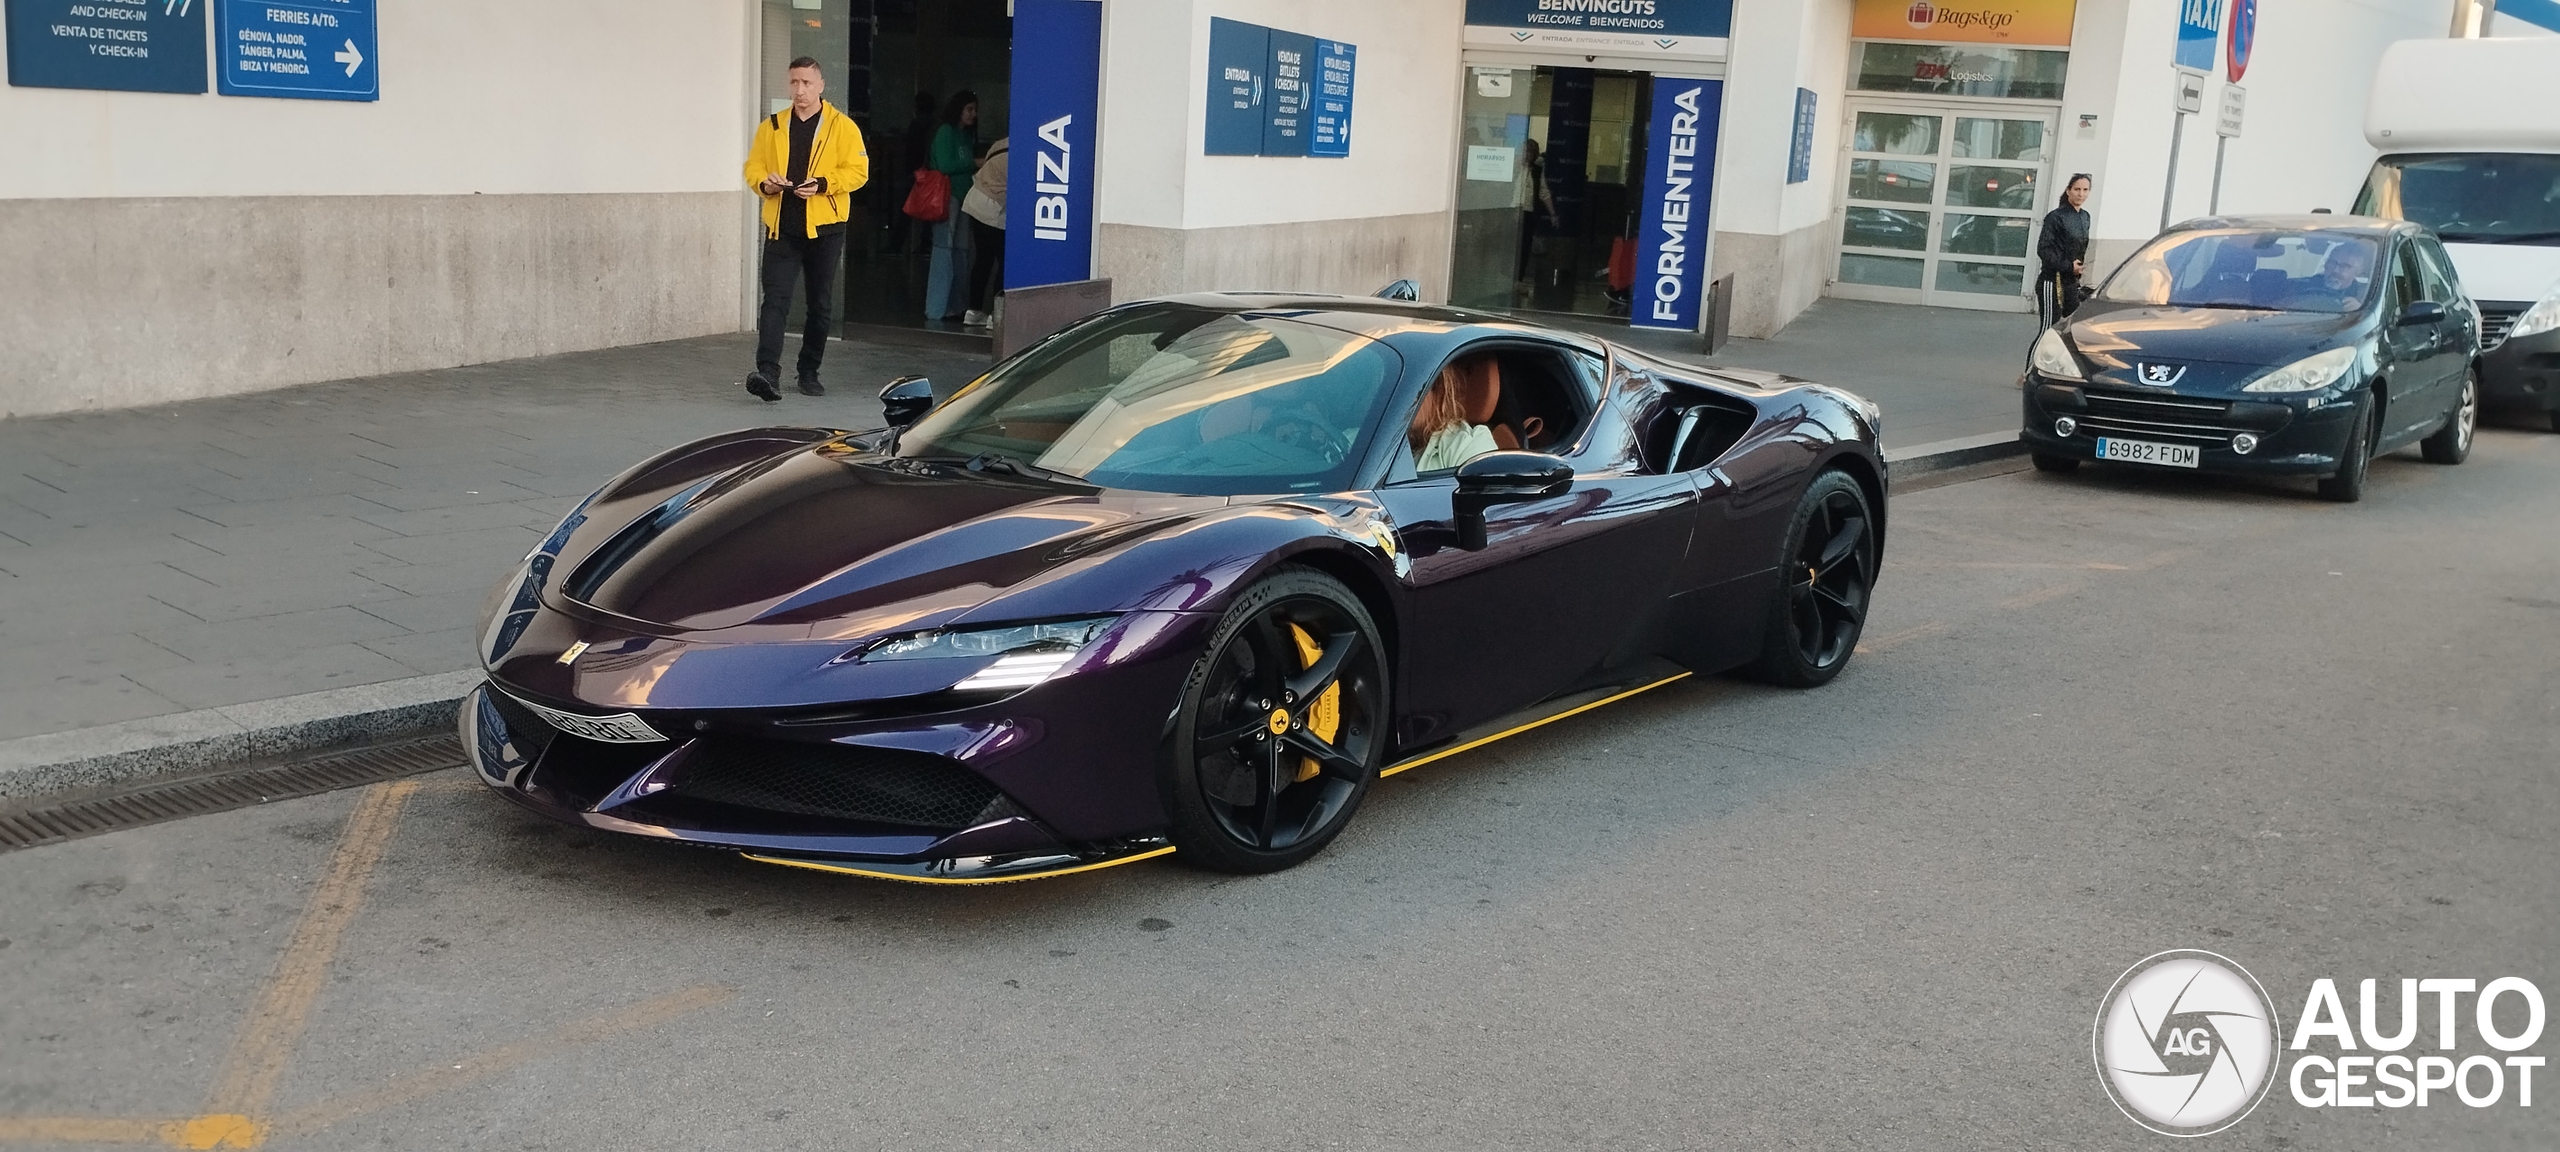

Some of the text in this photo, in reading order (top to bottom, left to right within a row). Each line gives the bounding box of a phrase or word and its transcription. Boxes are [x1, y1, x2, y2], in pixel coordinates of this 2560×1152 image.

[70, 5, 147, 21] AND CHECK-IN
[1538, 0, 1656, 15] BENVINGUTS
[2184, 0, 2220, 32] TAXI
[266, 8, 339, 28] FERRIES A/TO:
[1527, 13, 1665, 30] WELCOME BIENVENIDOS
[1936, 7, 2013, 30] Bags&go
[51, 24, 148, 42] VENTA DE TICKETS
[238, 27, 307, 46] GÉNOVA, NADOR,
[1542, 35, 1645, 47] ENTRADA ENTRANCE ENTRADA
[89, 44, 148, 58] Y CHECK-IN
[238, 43, 307, 61] TÁNGER, PALMA,
[1277, 50, 1294, 63] VENDA
[239, 60, 310, 75] IBIZA Y MENORCA
[1224, 67, 1250, 82] ENTRADA
[1951, 70, 1994, 82] Logistics
[1476, 154, 1506, 162] HORARIOS
[1034, 114, 1072, 241] IBIZA
[1652, 87, 1702, 321] FORMENTERA
[2109, 441, 2194, 464] 6982 FDM
[1209, 598, 1250, 649] MICHELIN
